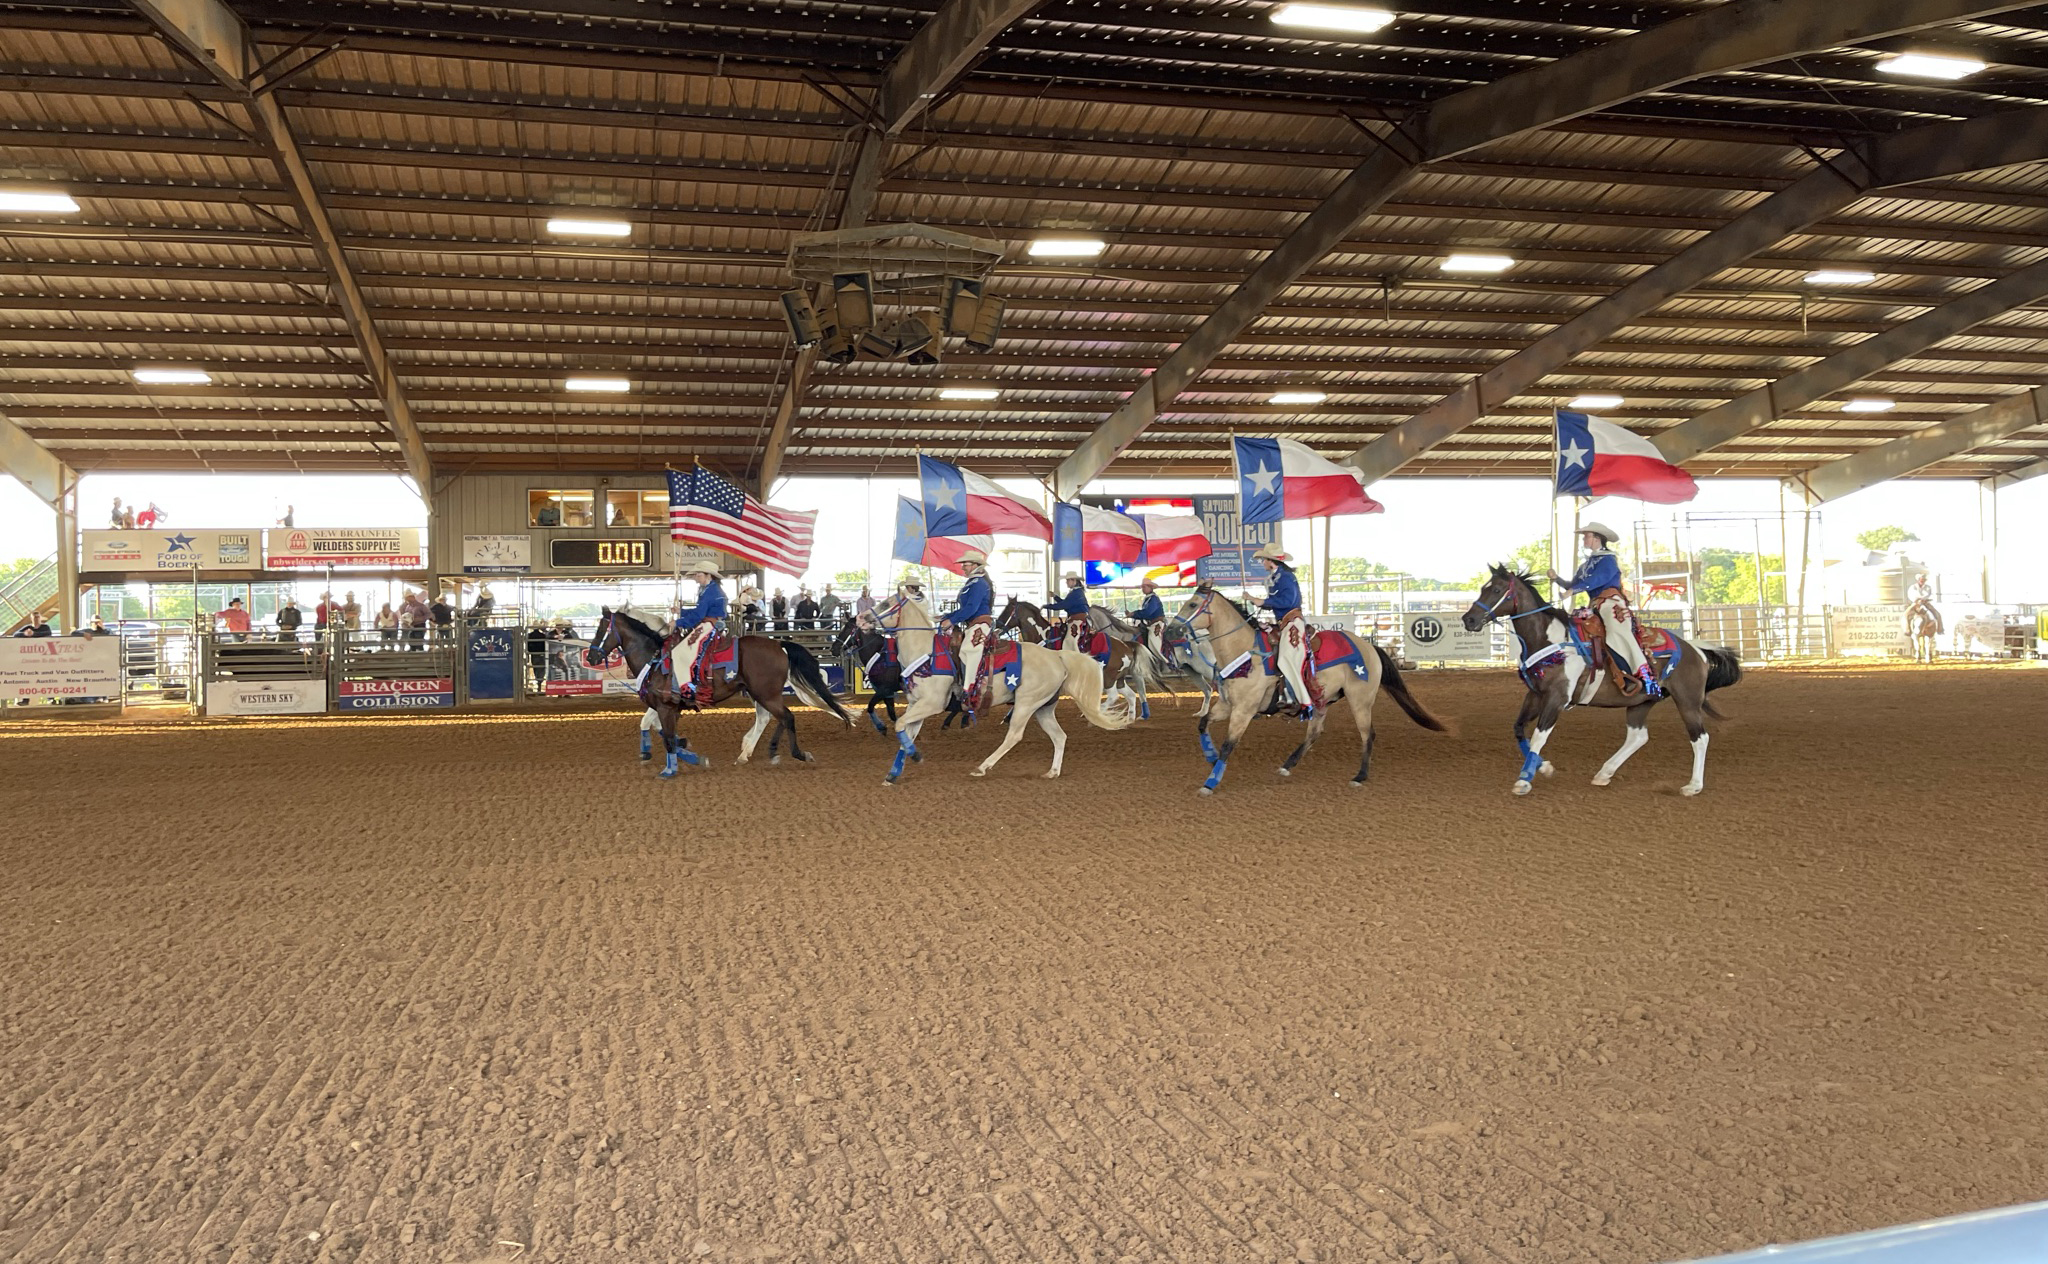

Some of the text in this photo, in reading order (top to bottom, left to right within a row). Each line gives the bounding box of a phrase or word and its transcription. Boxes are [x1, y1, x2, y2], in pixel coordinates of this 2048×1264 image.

[313, 529, 401, 538] NEW BRAUNFELS
[220, 535, 248, 545] BUILT
[313, 541, 354, 551] WELDERS
[356, 540, 387, 551] SUPPLY
[475, 541, 520, 559] TEJAS
[157, 553, 204, 561] FORD OF
[598, 542, 645, 564] 0.00
[219, 555, 249, 563] TOUGH
[273, 556, 416, 566] nbwelders.com 1-866-625-4484
[1845, 615, 1878, 623] ATTORNEYS
[1848, 631, 1898, 640] 210-223-2627
[471, 634, 511, 652] TEJAS
[19, 686, 87, 695] 800-676-0241
[352, 680, 441, 693] BRACKEN
[240, 693, 294, 704] WESTERN SKY
[352, 696, 441, 708] COLLISION
